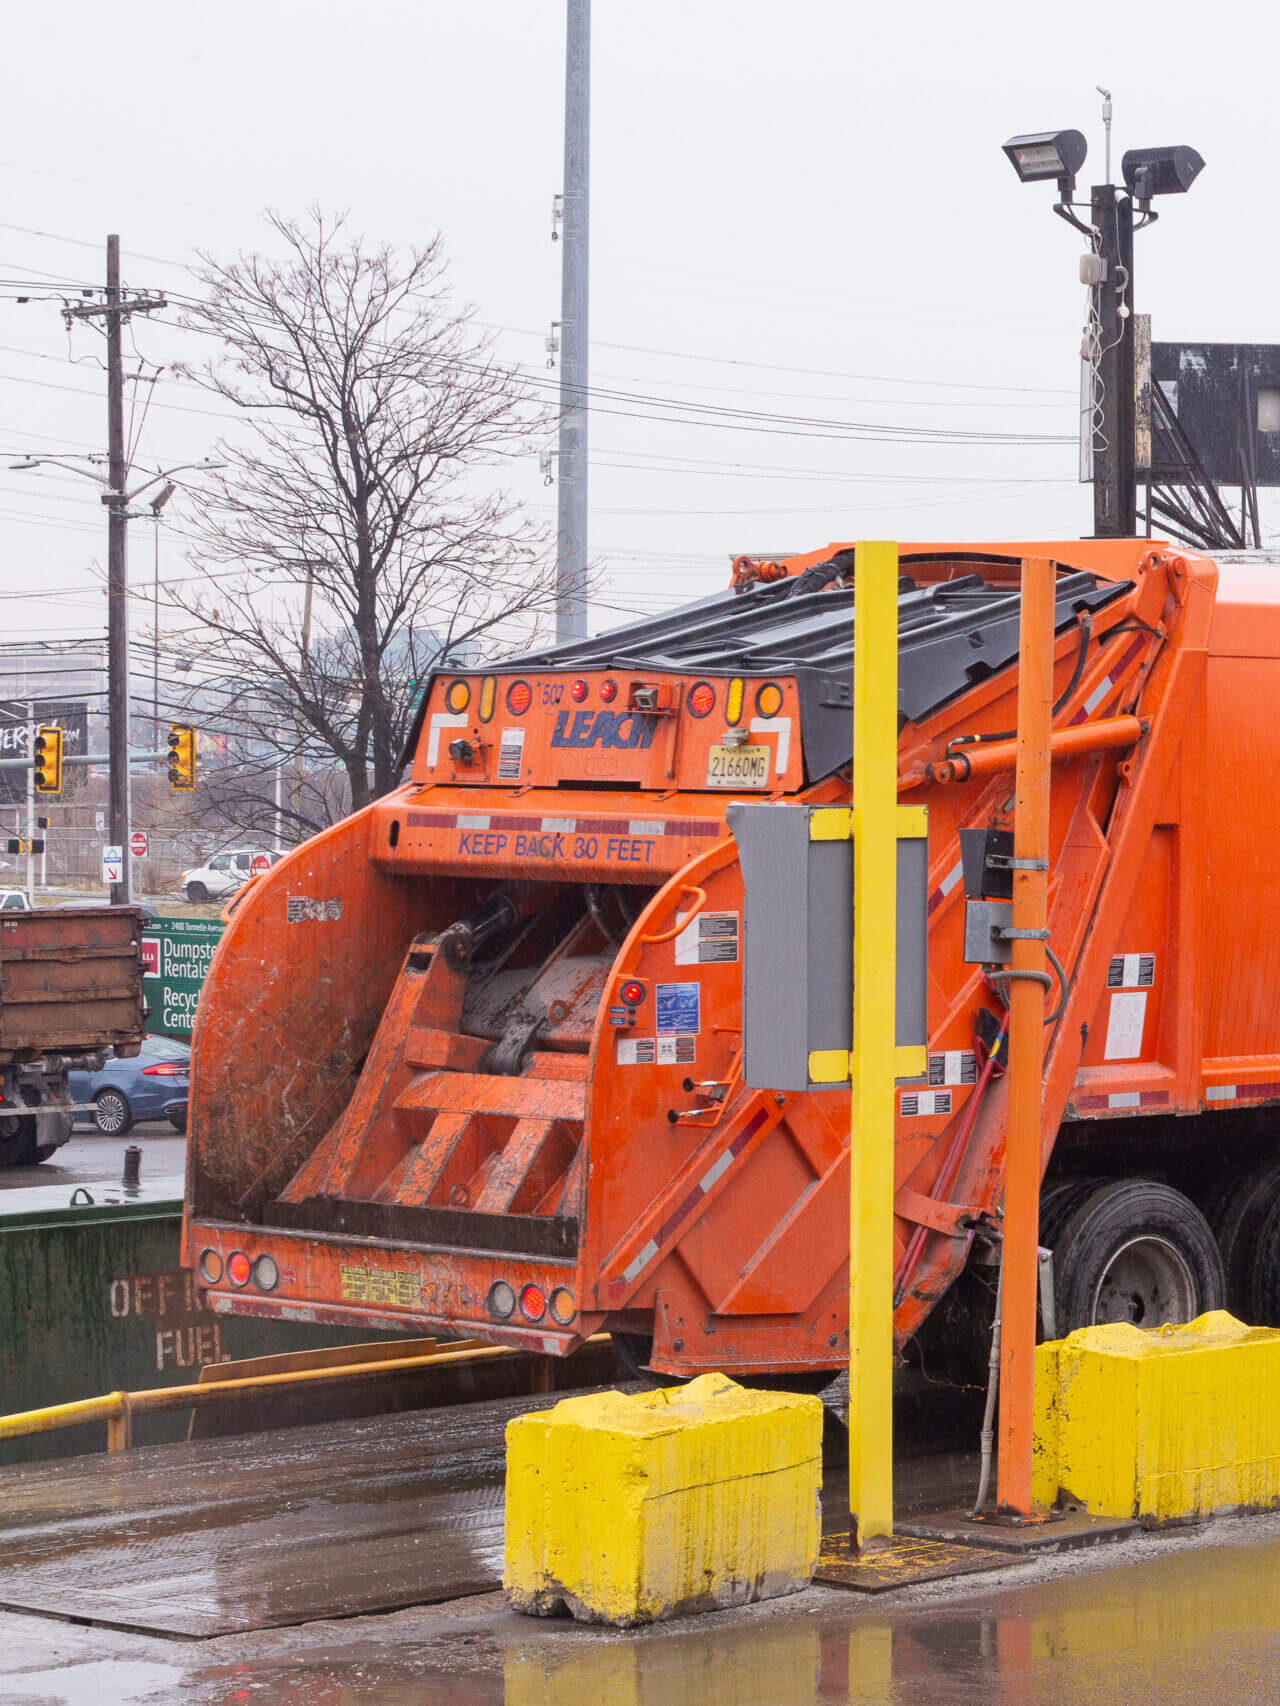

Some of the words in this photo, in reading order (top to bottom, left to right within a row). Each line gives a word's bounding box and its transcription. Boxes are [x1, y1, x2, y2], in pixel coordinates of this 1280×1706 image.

[542, 684, 568, 705] 507
[550, 710, 658, 749] LEACH
[712, 756, 765, 777] 21660MG
[459, 833, 508, 855] KEEP
[515, 835, 565, 858] BACK
[573, 837, 599, 859] 30
[606, 838, 656, 862] FEET
[164, 938, 219, 962] Dumpste
[163, 1008, 196, 1029] Cente
[156, 1323, 231, 1371] FUEL
